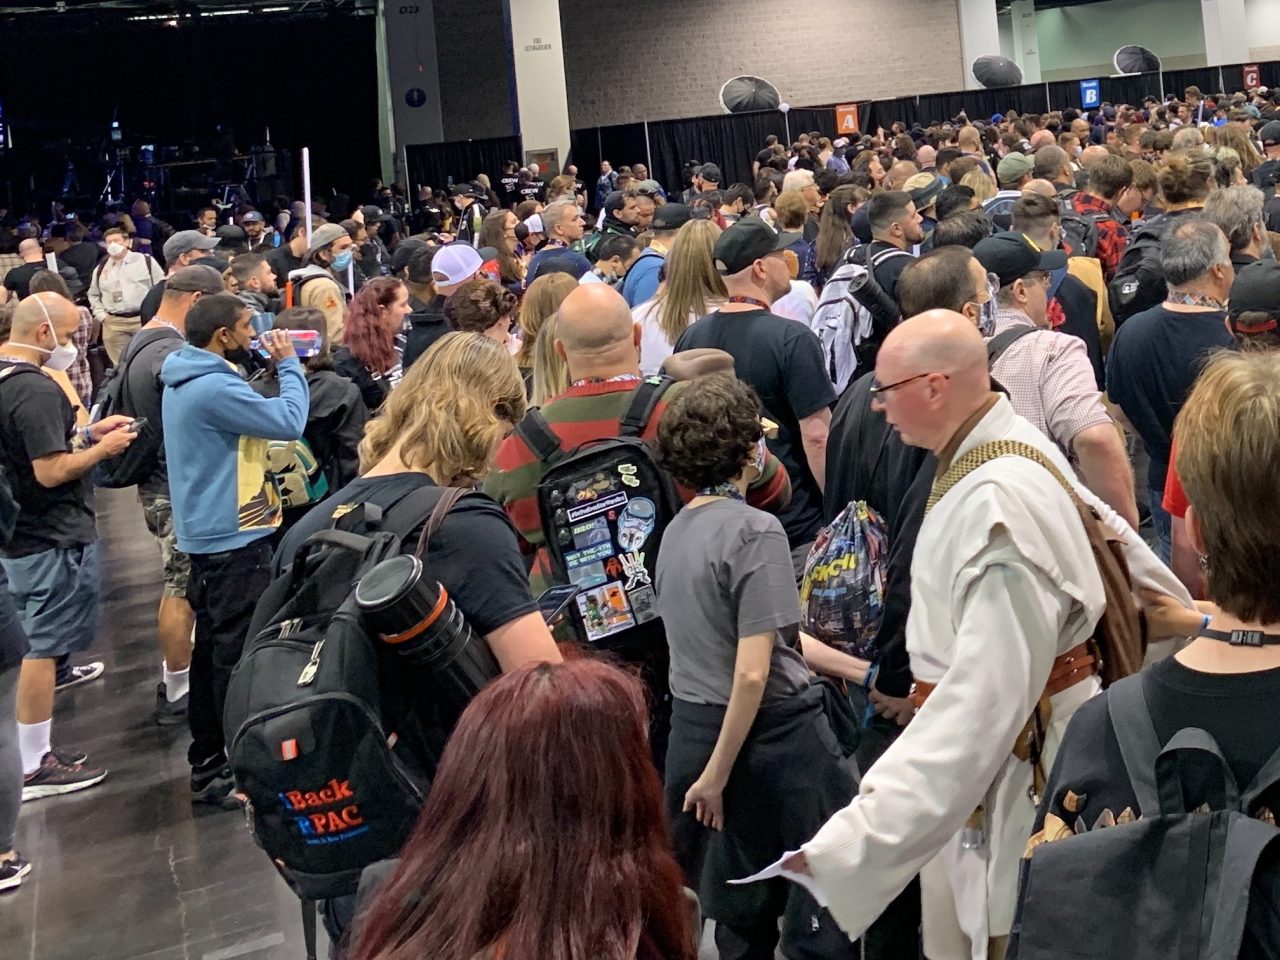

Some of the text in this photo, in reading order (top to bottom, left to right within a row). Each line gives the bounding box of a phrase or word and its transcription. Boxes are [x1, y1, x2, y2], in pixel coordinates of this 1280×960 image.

[1246, 73, 1257, 86] C
[1085, 89, 1097, 104] B
[842, 114, 855, 130] A
[520, 187, 539, 195] CREW
